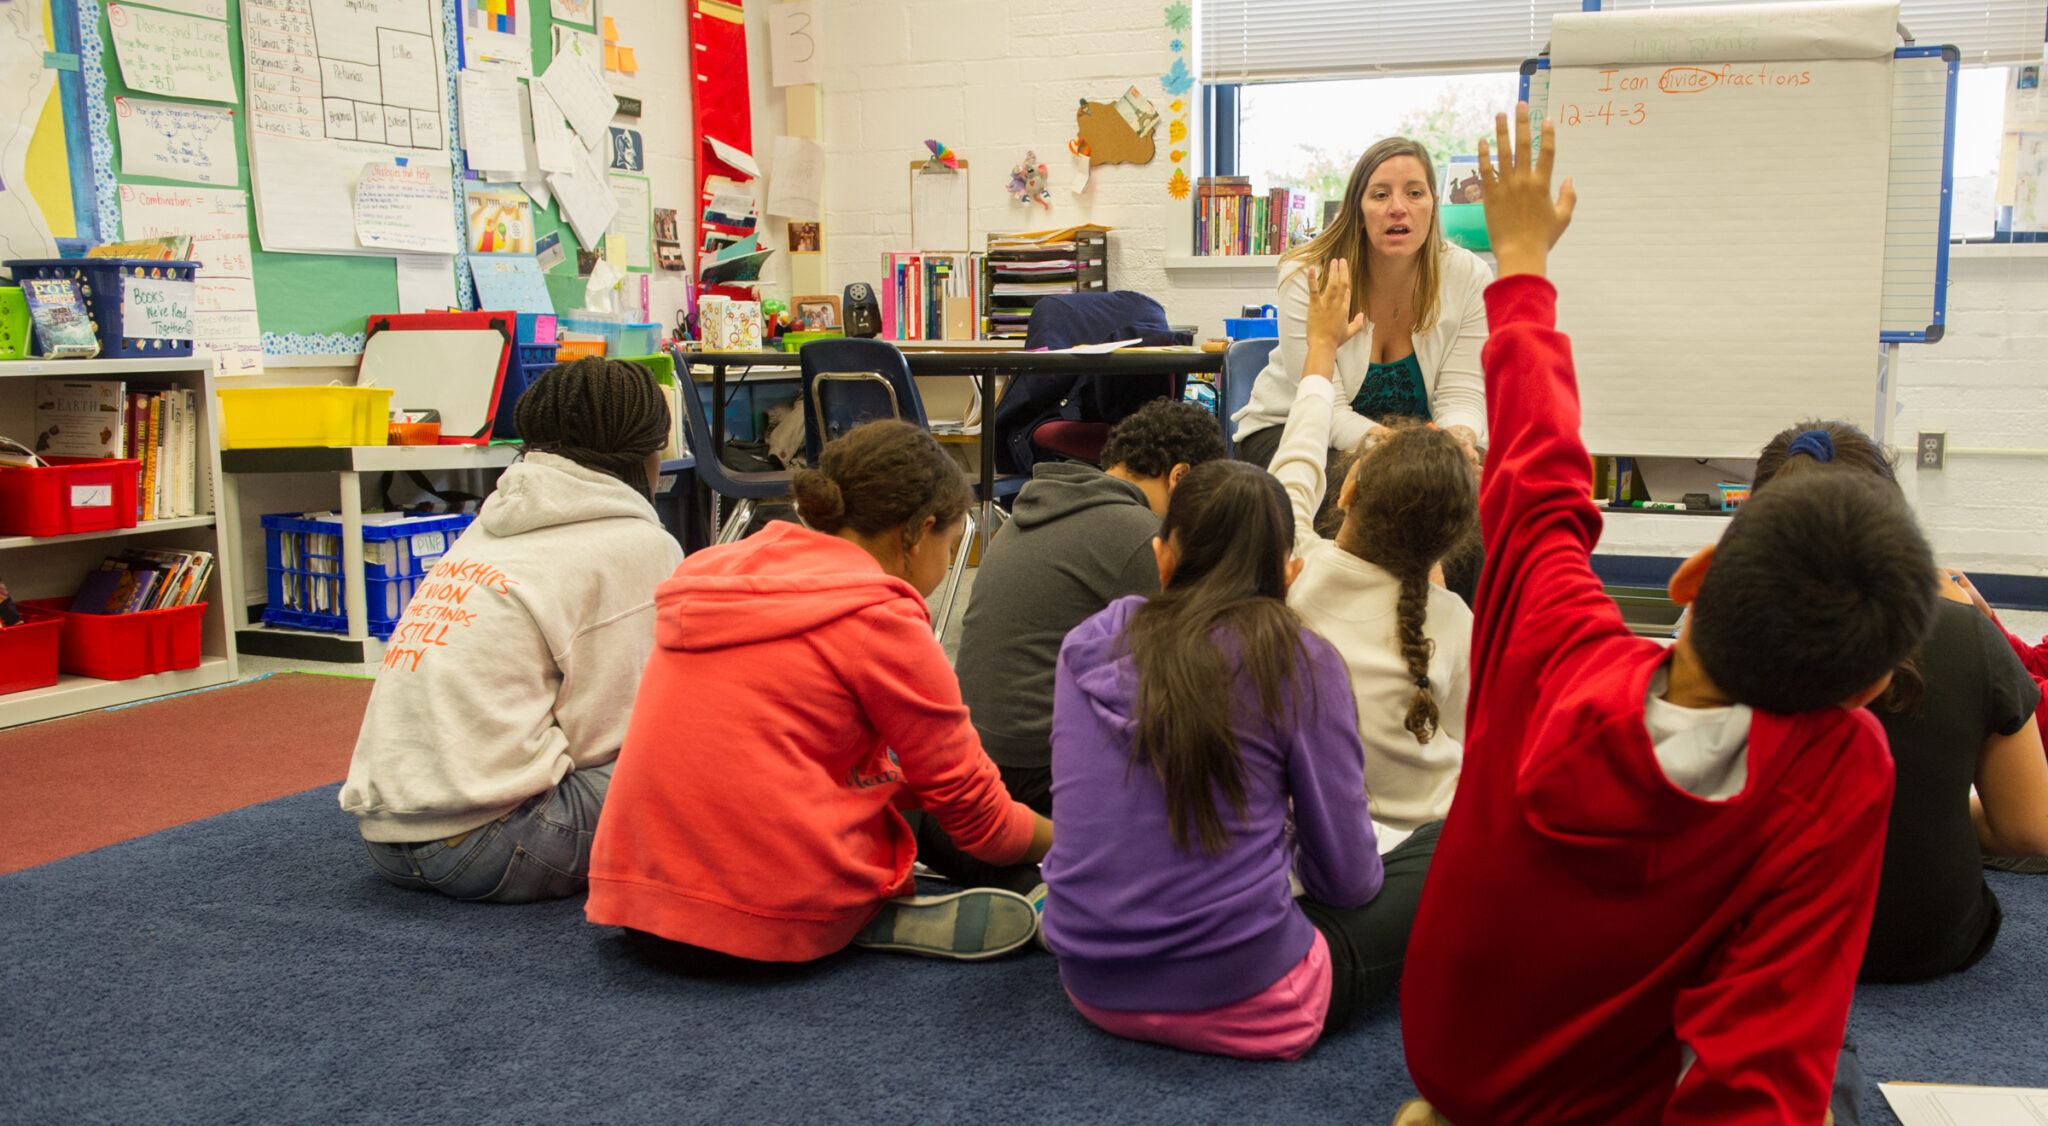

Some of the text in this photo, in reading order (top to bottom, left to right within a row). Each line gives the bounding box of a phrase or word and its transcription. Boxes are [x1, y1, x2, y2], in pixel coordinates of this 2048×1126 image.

[786, 11, 815, 63] 3
[1597, 63, 1811, 92] I can divide fractions
[254, 94, 288, 113] Daisies
[255, 113, 286, 134] Irises
[139, 192, 192, 209] Combinations
[33, 284, 74, 295] POE
[151, 320, 186, 337] Together
[56, 398, 98, 412] EARTH
[417, 535, 442, 554] PINE
[425, 583, 475, 605] WON
[424, 605, 478, 628] STANDS
[397, 621, 449, 646] STILL
